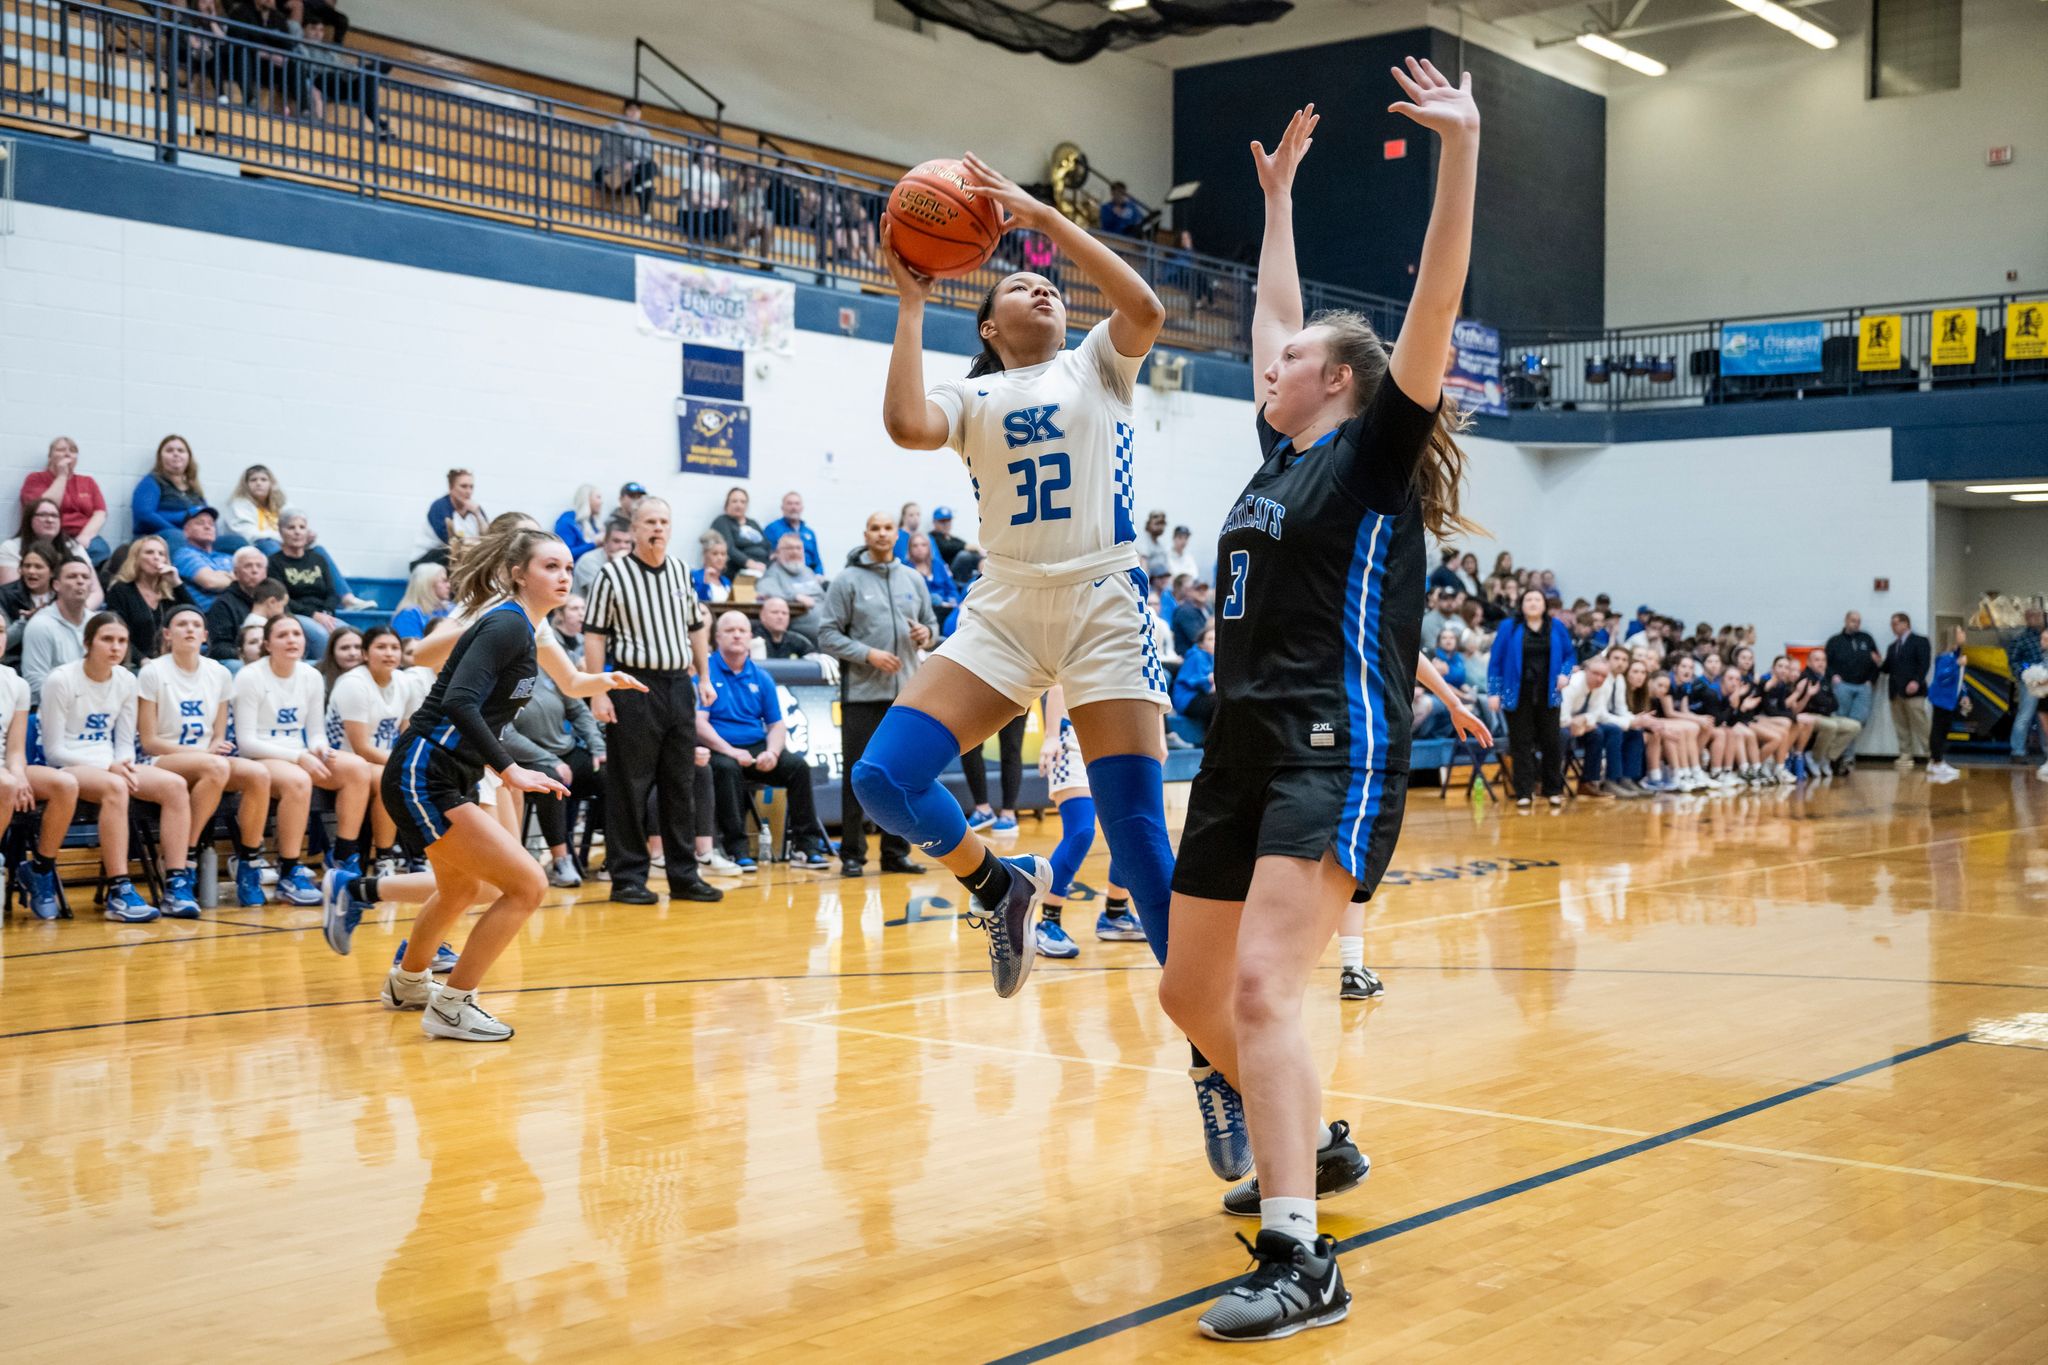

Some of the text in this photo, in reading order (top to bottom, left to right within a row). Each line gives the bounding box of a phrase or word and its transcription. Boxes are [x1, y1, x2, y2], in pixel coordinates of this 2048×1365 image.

[899, 188, 959, 220] LEGACY
[1002, 403, 1066, 449] SK
[1007, 452, 1072, 526] 32
[1223, 549, 1250, 620] 3
[180, 700, 204, 717] SK
[277, 707, 298, 723] SK
[85, 713, 110, 729] SK
[1311, 722, 1334, 732] 2XL
